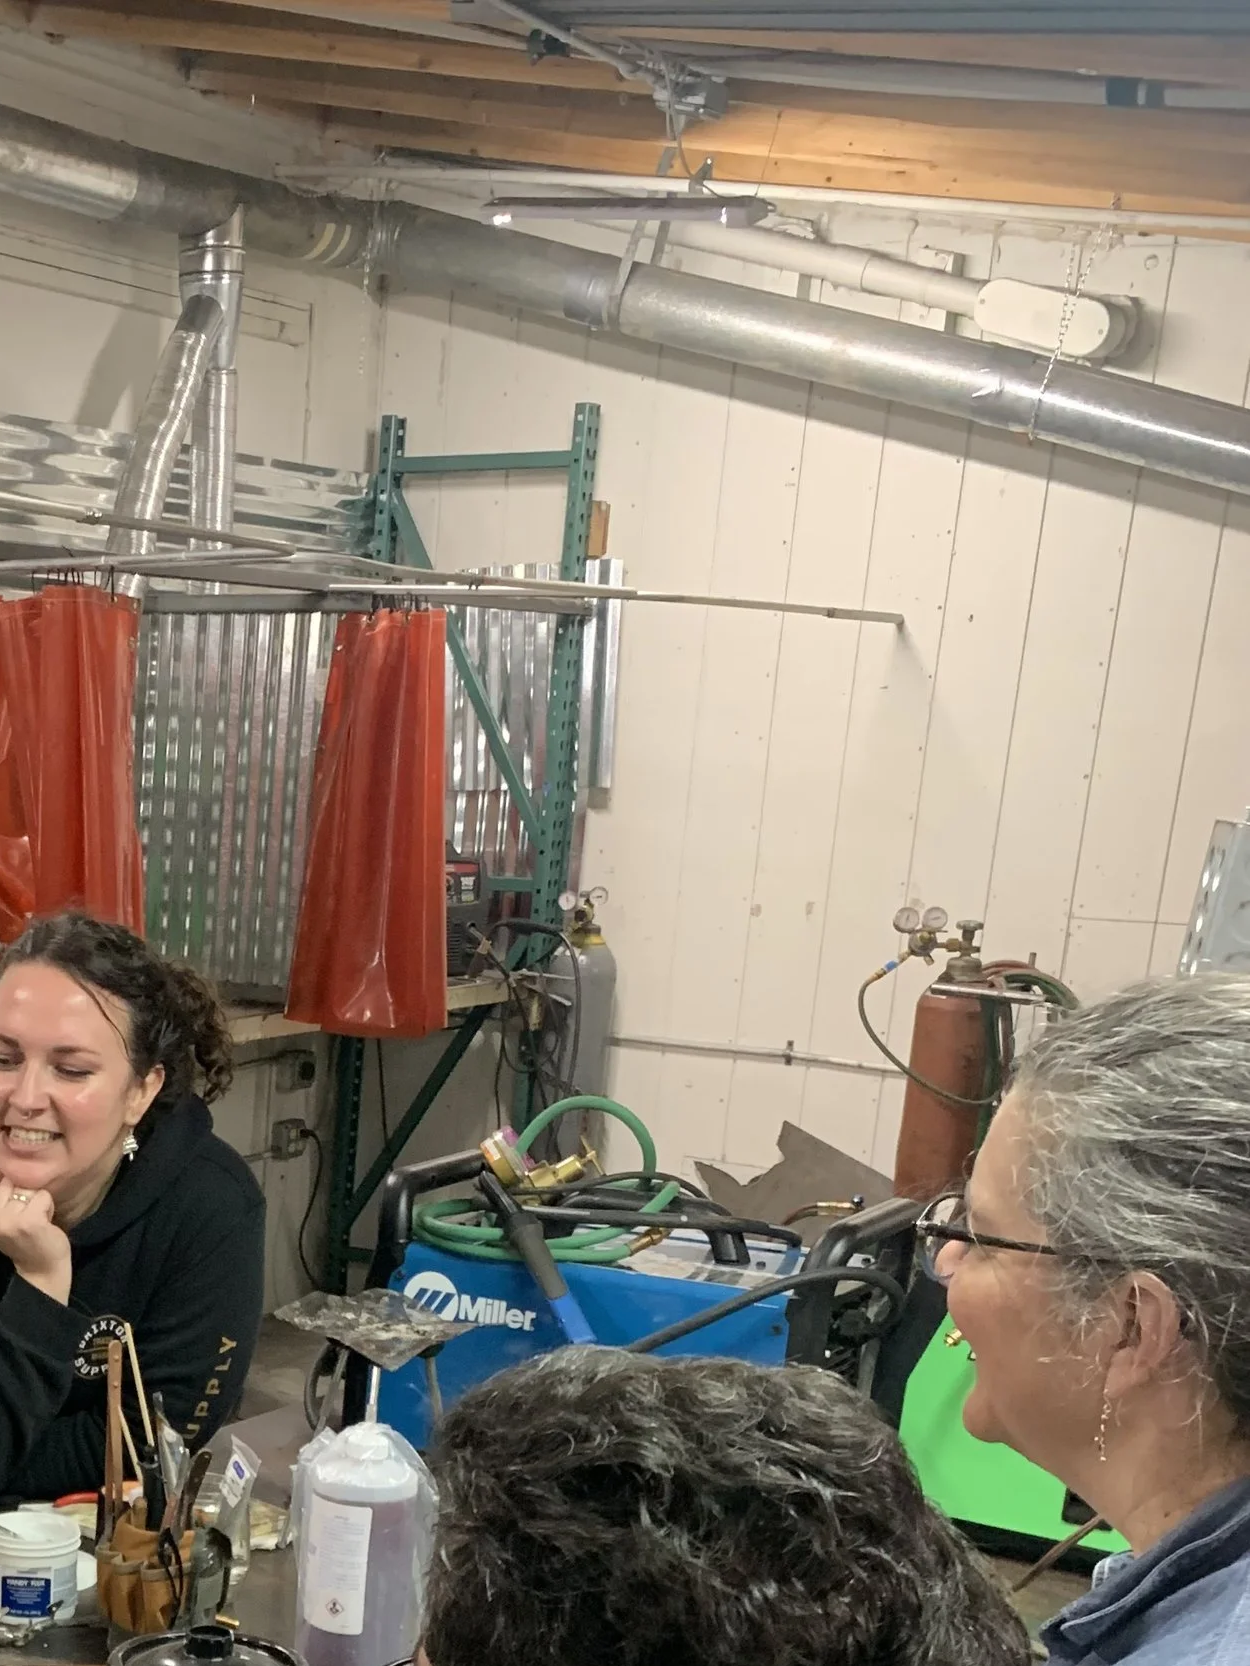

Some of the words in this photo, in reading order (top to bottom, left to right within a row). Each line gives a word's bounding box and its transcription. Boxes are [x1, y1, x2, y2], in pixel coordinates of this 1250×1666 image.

[458, 1293, 537, 1332] Miller
[74, 1356, 109, 1376] SUPP
[181, 1336, 238, 1440] UPPLY
